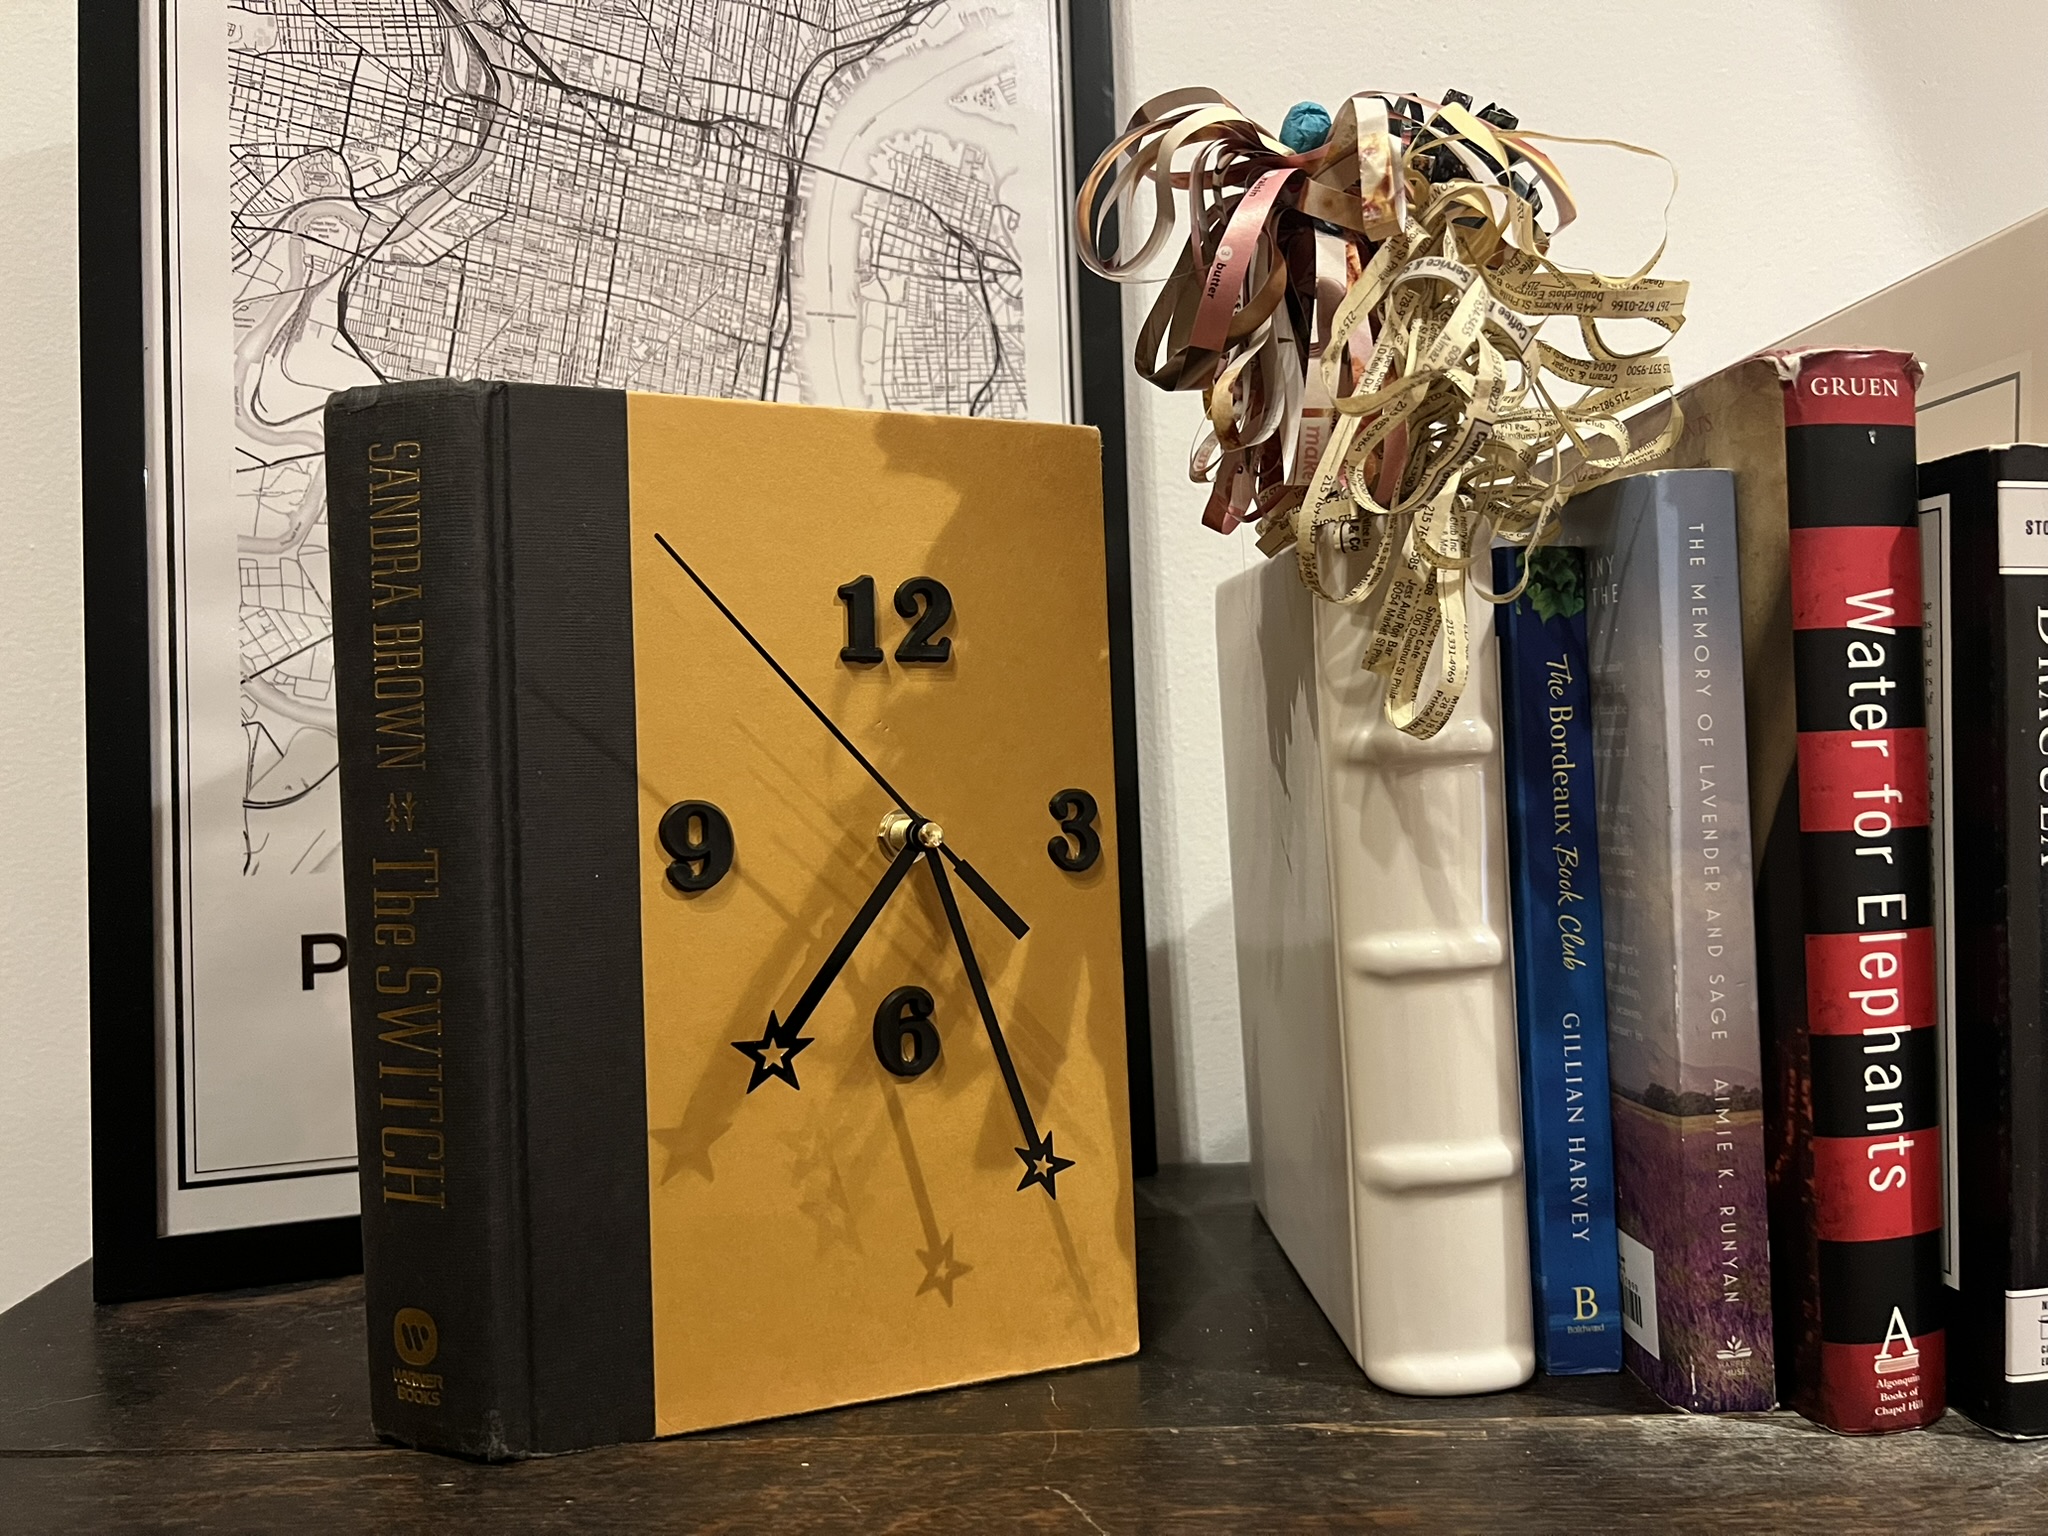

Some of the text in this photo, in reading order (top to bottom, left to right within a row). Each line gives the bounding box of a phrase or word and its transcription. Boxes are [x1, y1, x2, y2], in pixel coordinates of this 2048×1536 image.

[1207, 262, 1227, 300] butter
[1425, 257, 1471, 284] Service
[1505, 282, 1545, 299] Espresso
[1548, 291, 1605, 302] Doubleshots
[1611, 300, 1655, 312] 672-0166
[1655, 300, 1670, 312] 267
[1498, 306, 1528, 341] Coffee
[1430, 333, 1452, 363] Almaz
[1551, 359, 1576, 377] Sugar
[1589, 372, 1618, 384] Cream
[1593, 361, 1617, 371] 4004
[1626, 364, 1662, 376] 537-9500
[1618, 390, 1631, 402] 215
[1810, 376, 1899, 398] GRUEN
[1303, 425, 1321, 482] make
[1421, 504, 1436, 523] 215
[1450, 538, 1459, 552] Inc
[1389, 581, 1405, 606] 6054
[1404, 579, 1418, 599] Jess
[836, 574, 953, 664] 12
[1378, 607, 1397, 636] Market
[1396, 600, 1411, 621] And
[1375, 637, 1386, 648] St
[1411, 606, 1437, 659] Sphinx Cafe
[1385, 640, 1398, 657] Bar
[1399, 627, 1418, 665] Chestnut
[1446, 618, 1457, 684] 215 331-4969
[1395, 666, 1405, 676] St
[1389, 677, 1402, 699] Phila
[1423, 689, 1444, 717] Prince
[368, 440, 446, 1209] SANDRA BROWN The SWITCH
[1546, 653, 1587, 972] The Bordeaux Book Club
[1047, 788, 1101, 873] 3
[658, 800, 734, 893] 9
[1845, 588, 1915, 1192] Water for Elephants
[1688, 523, 1740, 1303] THE MEMORY OF LAVENDER AND SAGE AIMIE K. RUNYAN
[301, 933, 348, 991] P
[873, 985, 941, 1077] 6
[1562, 1012, 1591, 1243] GILLIAN HARVEY
[1573, 1286, 1599, 1321] B
[1874, 1306, 1920, 1360] A
[1876, 1374, 1921, 1391] Algonquin
[1880, 1386, 1919, 1402] Books of
[397, 1385, 442, 1407] BOOKS
[1874, 1399, 1924, 1417] Chapel Hill
